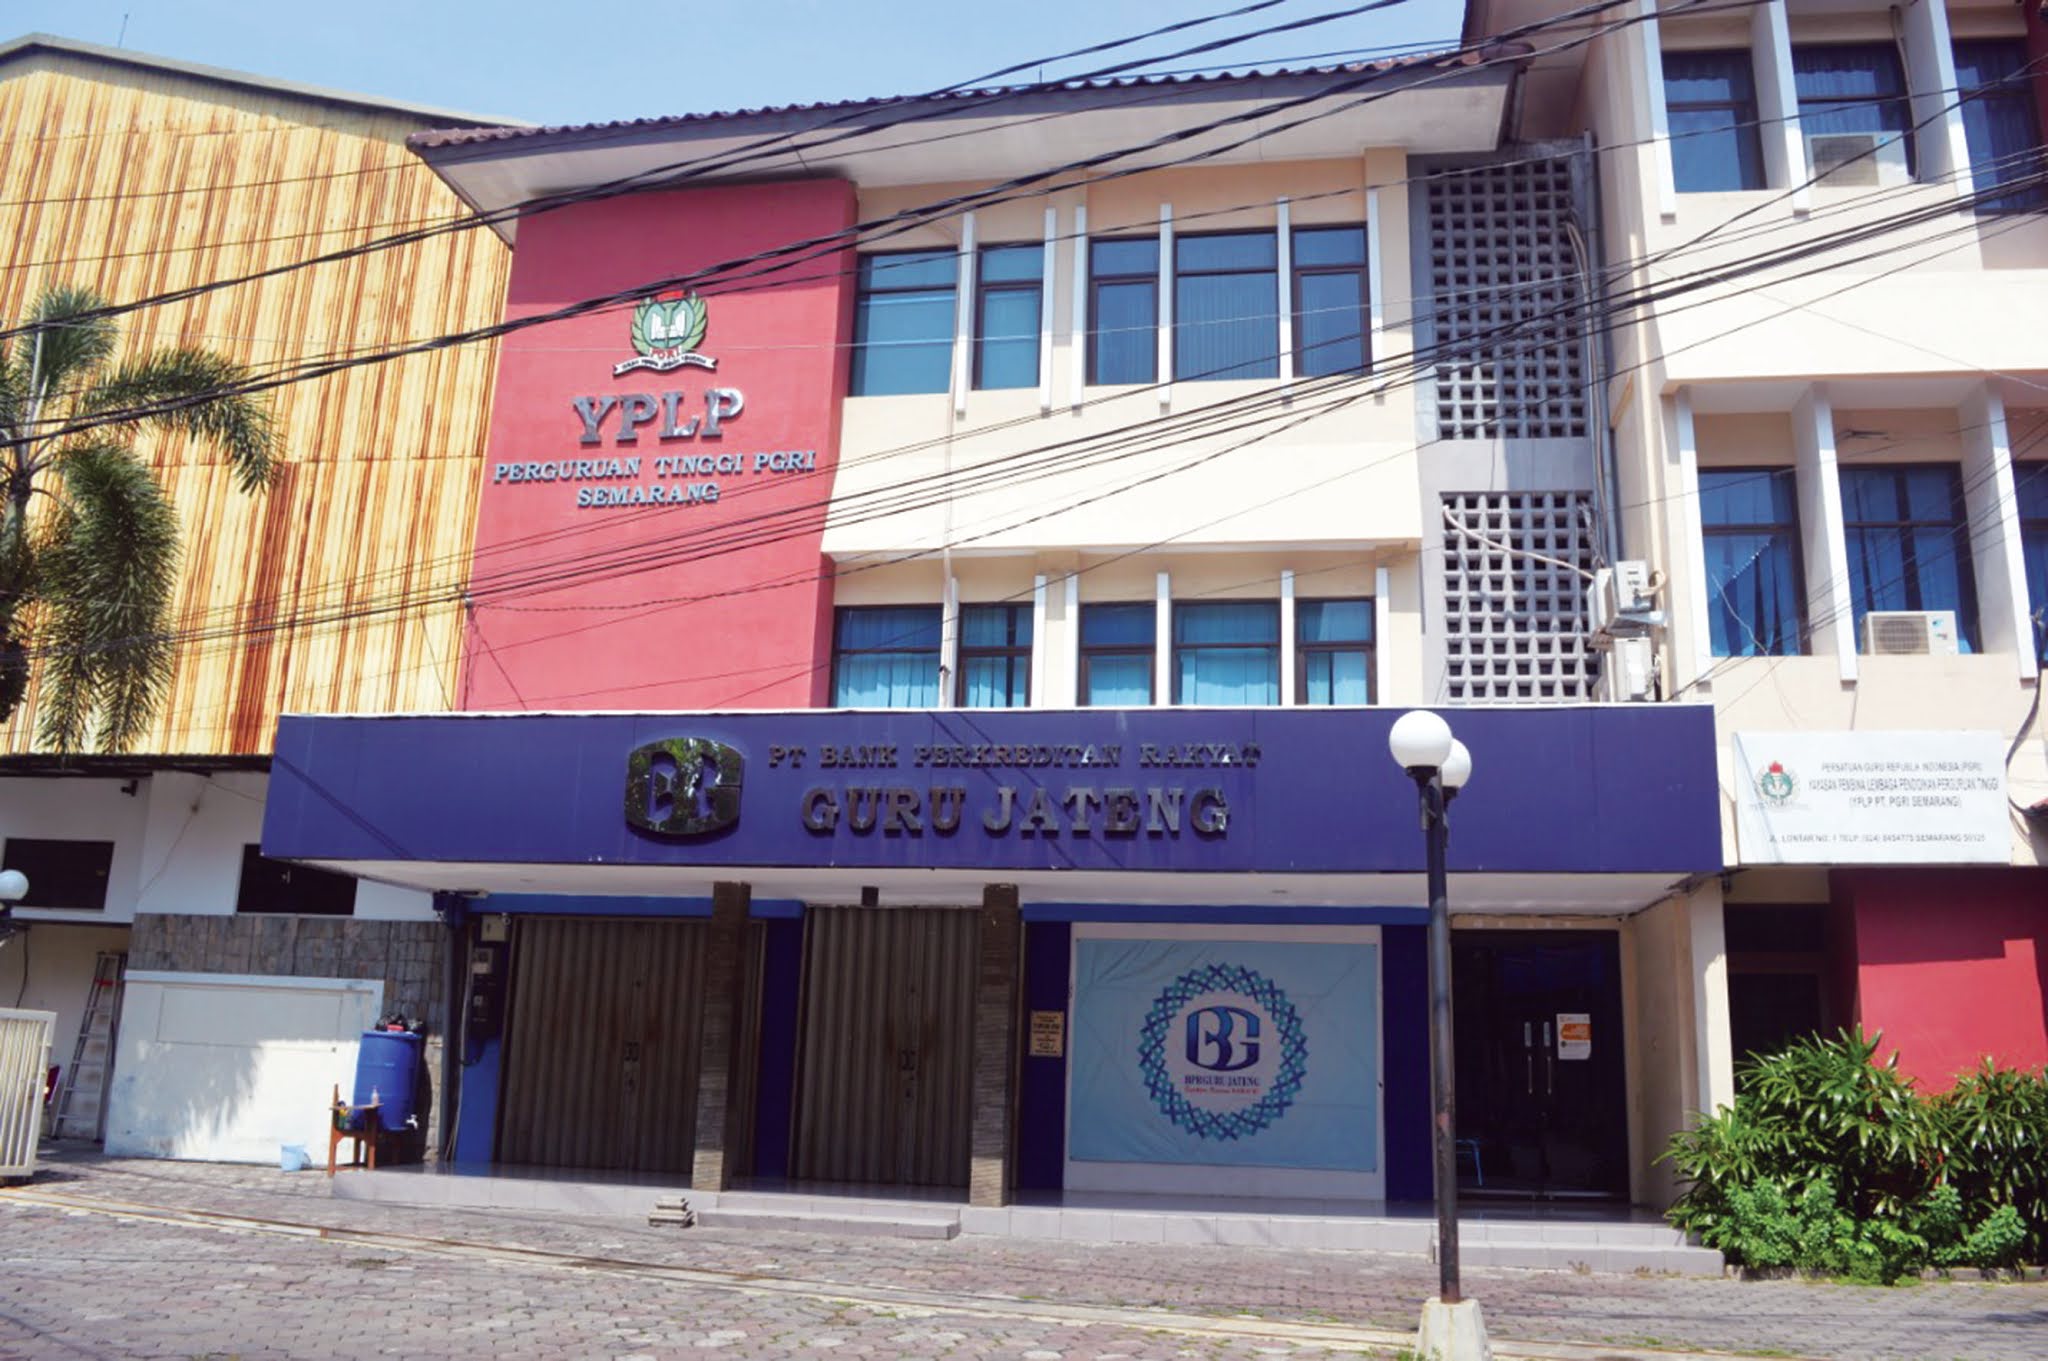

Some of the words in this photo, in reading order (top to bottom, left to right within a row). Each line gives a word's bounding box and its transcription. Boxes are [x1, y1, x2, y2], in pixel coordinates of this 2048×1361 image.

[572, 387, 744, 443] YPLP
[494, 456, 641, 483] PERGURUAN
[656, 453, 743, 477] TINGGI
[754, 450, 816, 472] PGRI
[577, 482, 720, 507] SEMARANG
[768, 744, 806, 768] PT
[820, 744, 897, 768] BANK
[914, 743, 1122, 768] PERKREDITAN
[1140, 743, 1260, 768] RAKYAT
[803, 786, 966, 837] GURU
[982, 786, 1231, 840] JATENG
